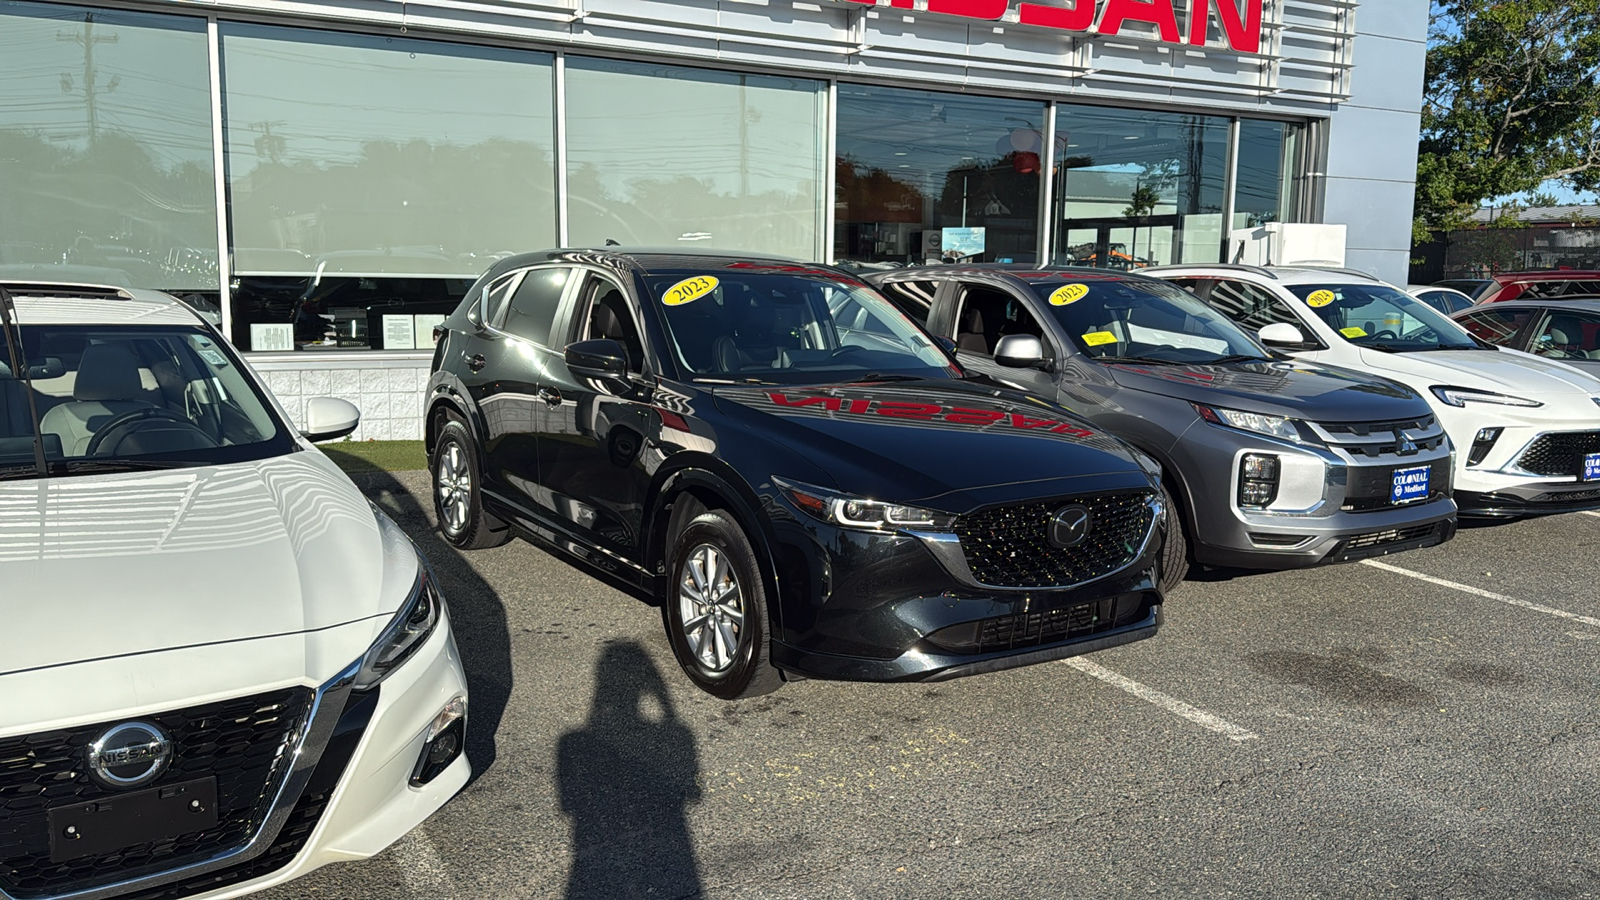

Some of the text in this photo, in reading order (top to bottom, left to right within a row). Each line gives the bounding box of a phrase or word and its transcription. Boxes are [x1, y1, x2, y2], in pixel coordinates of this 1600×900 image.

[847, 0, 1262, 54] SAN
[672, 277, 710, 302] 2023
[1056, 285, 1083, 303] 2023
[1310, 290, 1331, 306] 2024
[1393, 472, 1428, 486] COLONIAL
[1404, 483, 1426, 493] Medford
[99, 744, 162, 764] NISSAN
